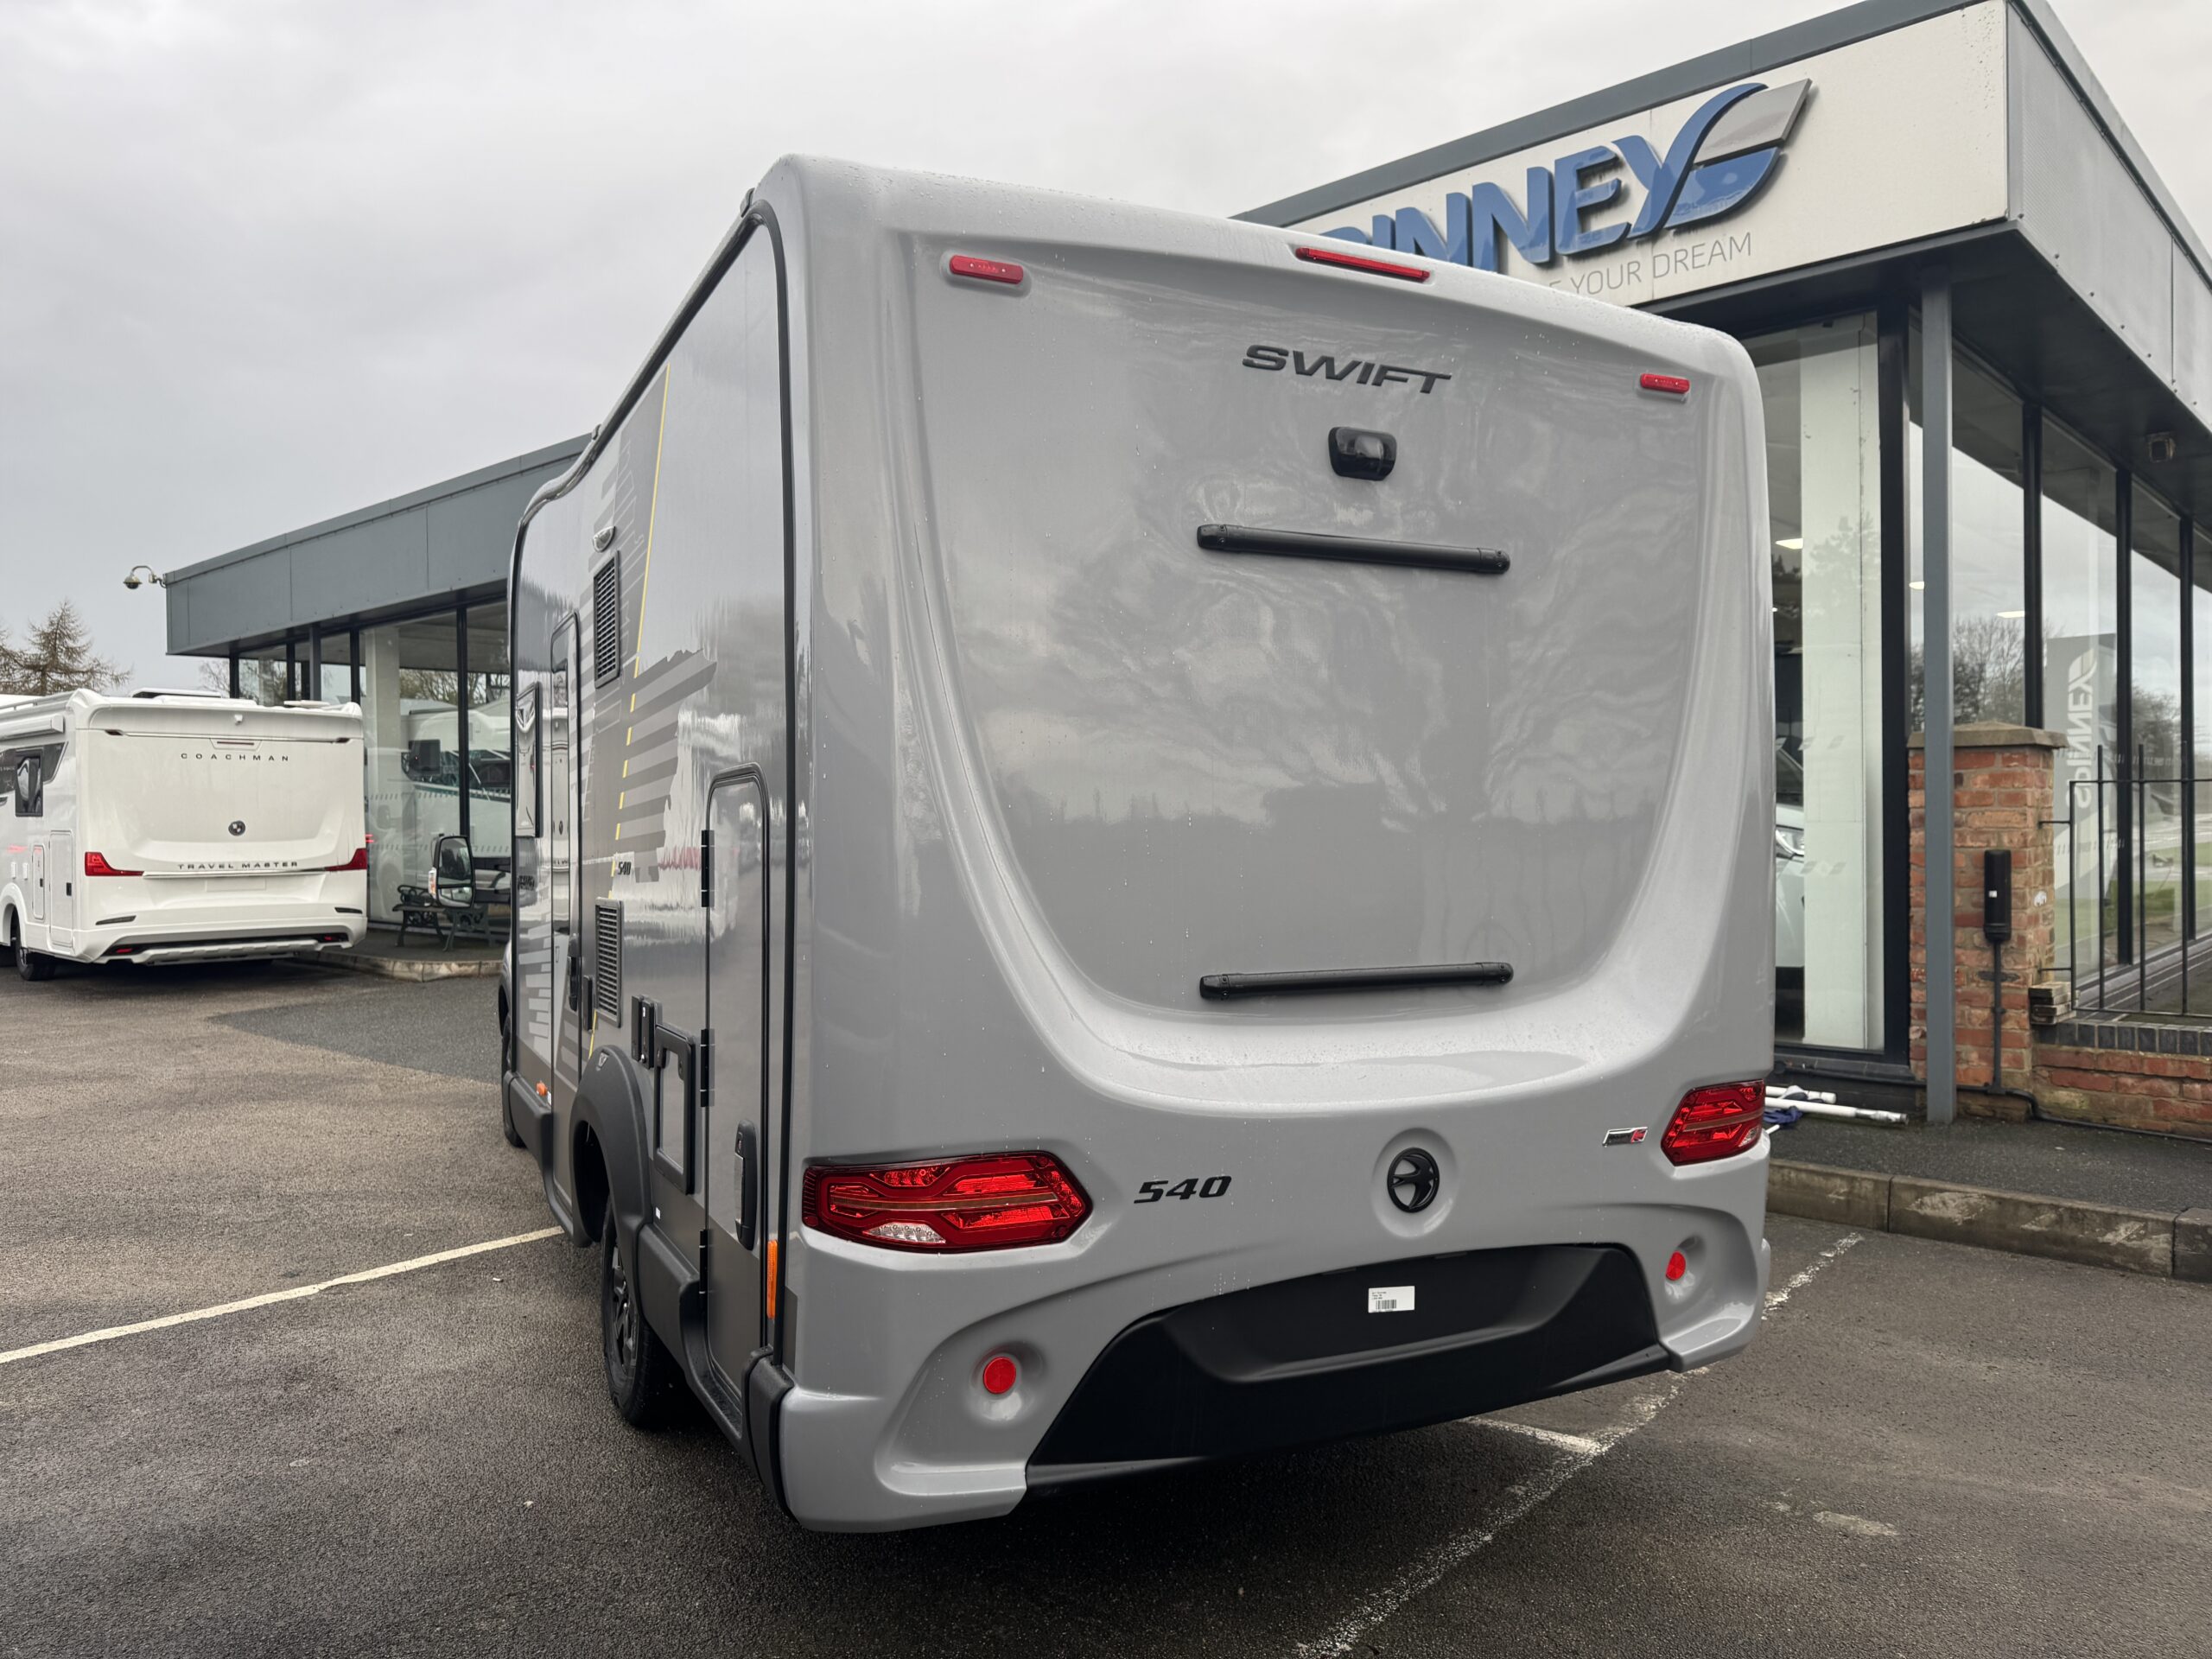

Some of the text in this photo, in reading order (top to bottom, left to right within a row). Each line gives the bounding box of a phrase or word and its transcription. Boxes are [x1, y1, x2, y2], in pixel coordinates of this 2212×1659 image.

[1570, 232, 1751, 295] YOUR DREAM
[1242, 344, 1452, 394] SWIFT
[181, 753, 289, 762] COACHMAN
[617, 861, 632, 875] 540
[1133, 1175, 1232, 1204] 540
